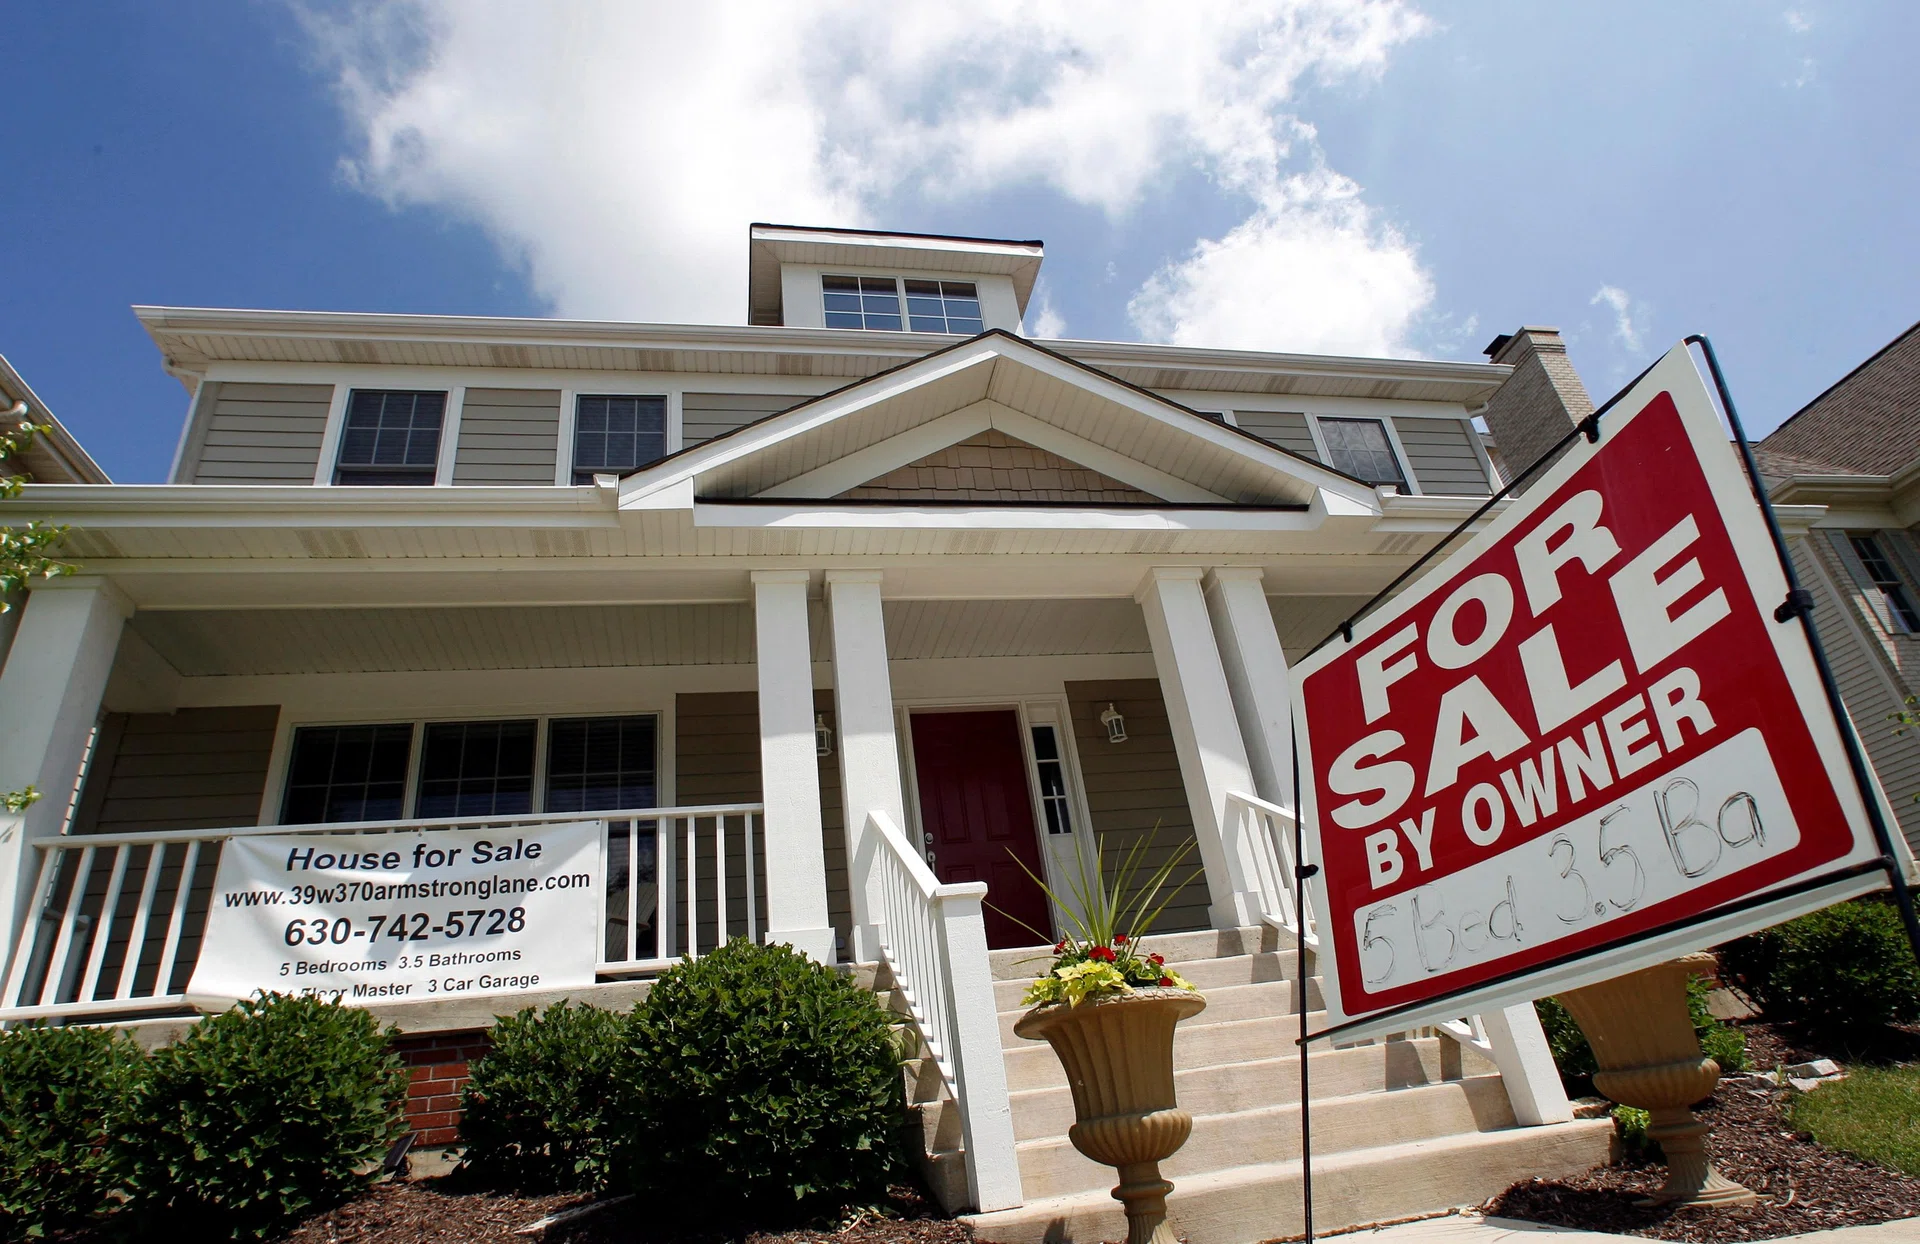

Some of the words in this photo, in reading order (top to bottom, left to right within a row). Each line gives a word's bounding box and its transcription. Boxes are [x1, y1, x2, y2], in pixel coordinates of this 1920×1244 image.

[1356, 489, 1623, 725] FOR
[1328, 514, 1732, 829] SALE
[1364, 807, 1437, 891] BY
[1461, 666, 1717, 847] OWNER
[287, 847, 401, 872] House
[412, 843, 462, 869] for
[471, 838, 543, 864] Sale
[225, 873, 591, 908] www.39w370armstronglane.com
[1363, 903, 1397, 984] 5
[1411, 874, 1524, 973] Bed
[1547, 803, 1648, 926] 3.5
[1653, 776, 1767, 880] Ba
[283, 906, 526, 947] 630-742-5728
[279, 963, 289, 977] 5
[295, 959, 388, 976] Bedrooms
[398, 955, 424, 970] 3.5
[428, 949, 522, 967] Bathrooms
[352, 983, 413, 998] Master
[427, 979, 438, 994] 3
[443, 977, 473, 993] Car
[478, 973, 540, 990] Garage
